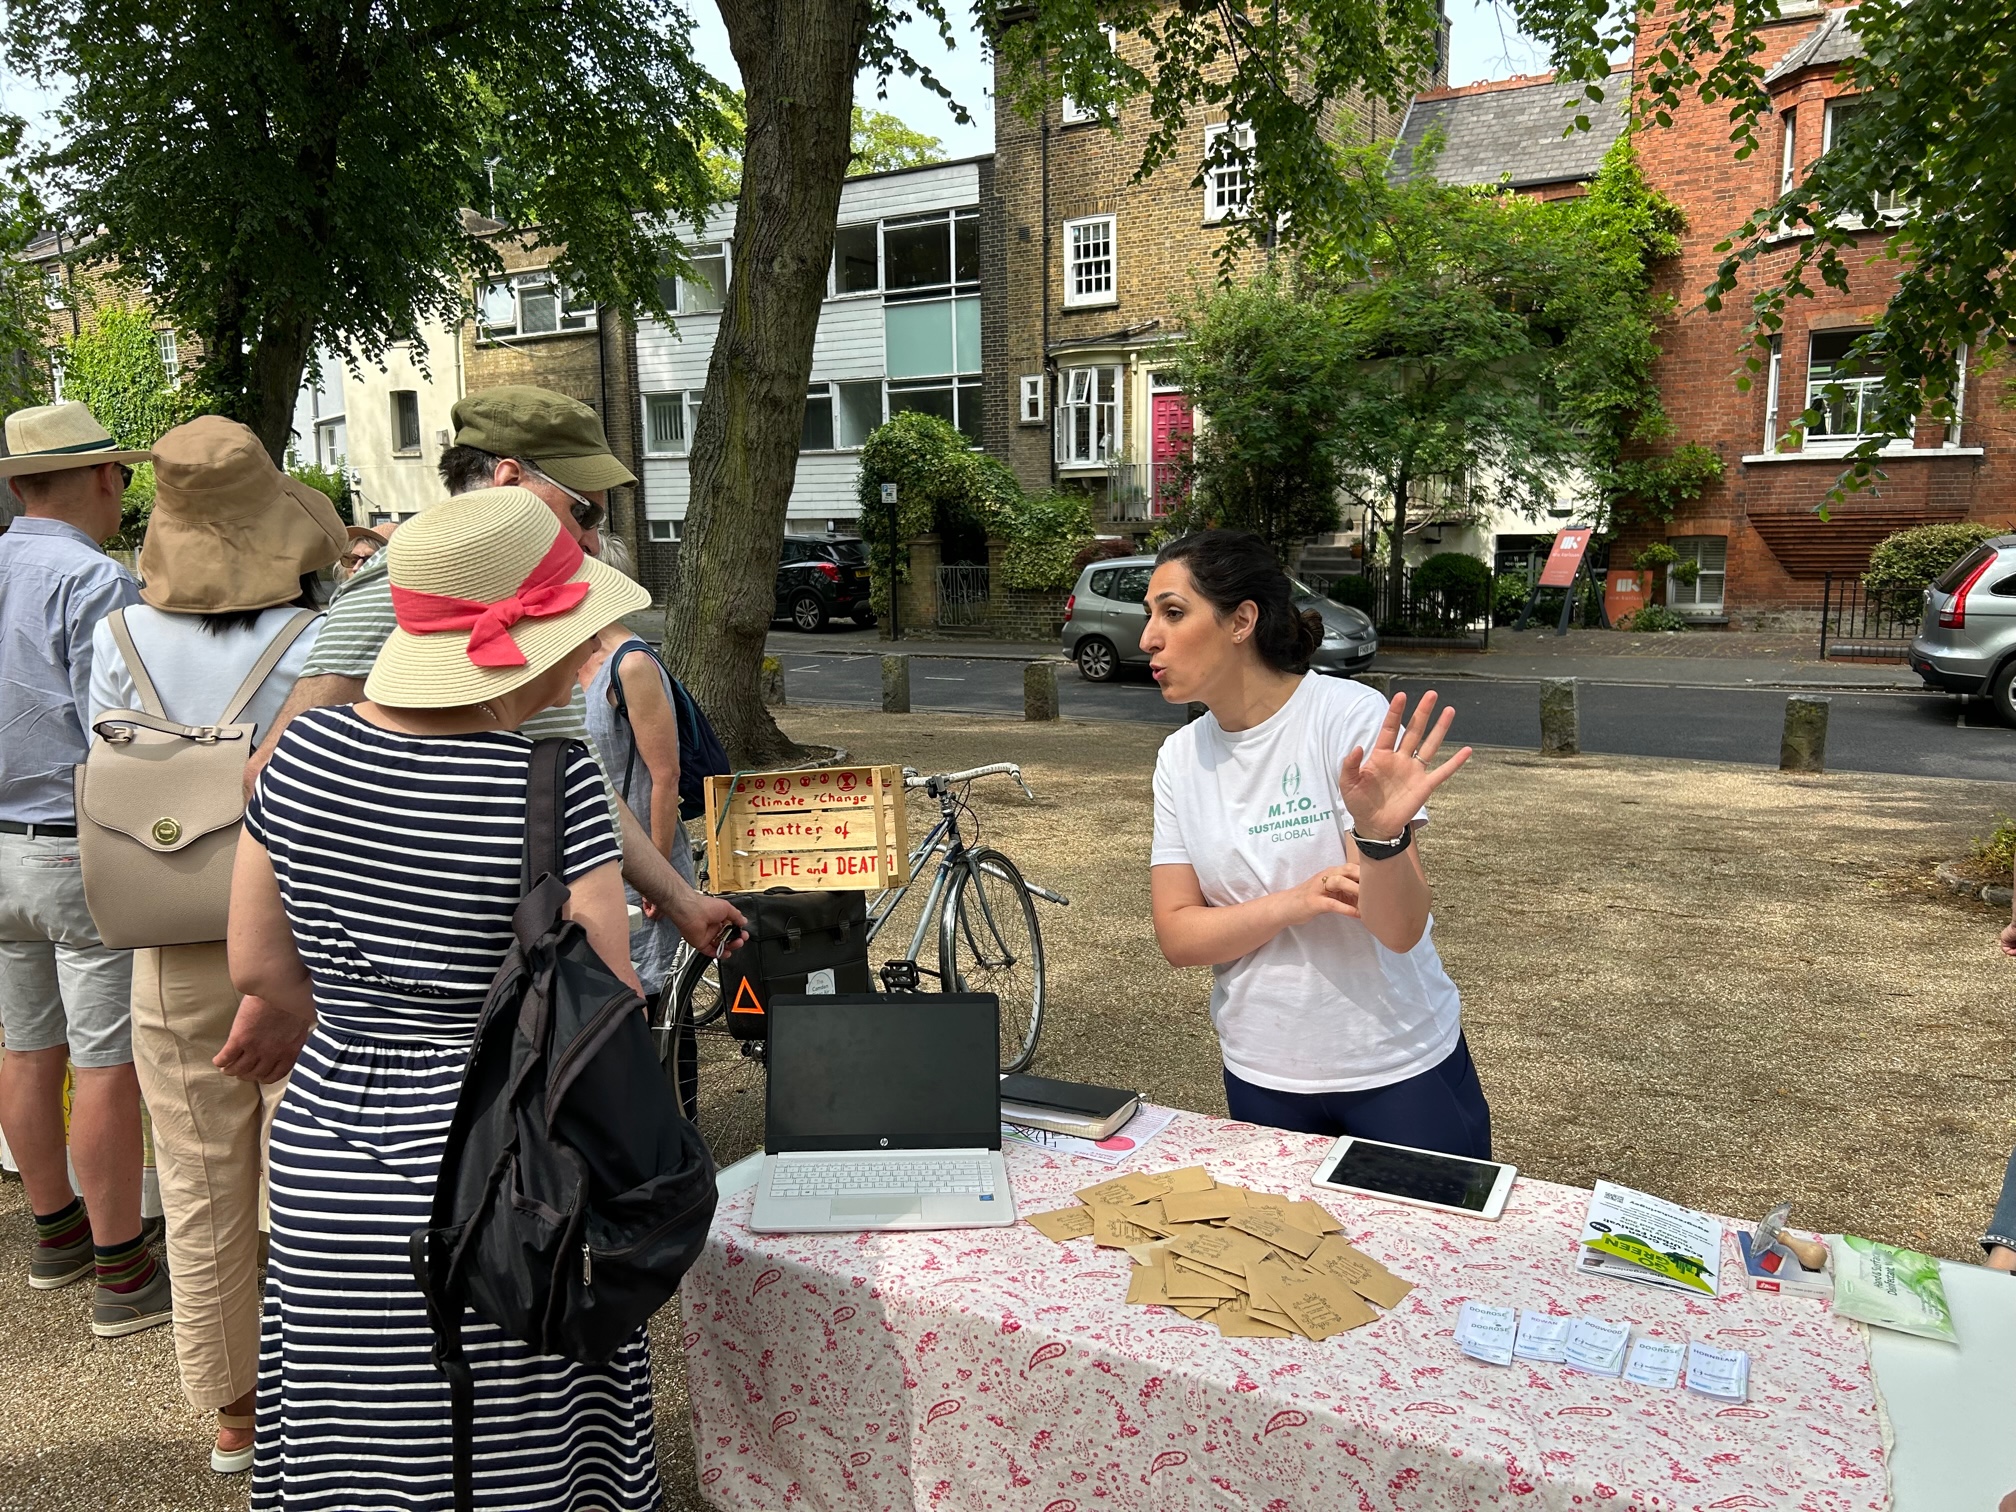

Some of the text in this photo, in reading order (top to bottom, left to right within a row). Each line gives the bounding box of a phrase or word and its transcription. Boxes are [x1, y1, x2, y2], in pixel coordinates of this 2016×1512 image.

[751, 792, 867, 808] Climate Change
[1268, 797, 1316, 818] M.T.O.
[747, 821, 850, 840] a matter of
[1271, 828, 1315, 843] GLOBAL
[759, 857, 800, 877] LIFE
[806, 861, 828, 875] and
[1604, 1237, 1669, 1265] GREEN
[1637, 1256, 1669, 1273] GO
[1870, 1250, 1882, 1271] Surfac
[1873, 1275, 1883, 1289] Hand
[1884, 1267, 1898, 1296] Disinfectant
[1469, 1306, 1508, 1317] DOGROSE
[1471, 1323, 1508, 1332] DOGROSE
[1531, 1316, 1558, 1325] ROWAN
[1585, 1321, 1622, 1335] DOGWOOD
[1639, 1343, 1679, 1354] DOGROSE
[1693, 1348, 1737, 1362] HORNBEAM
